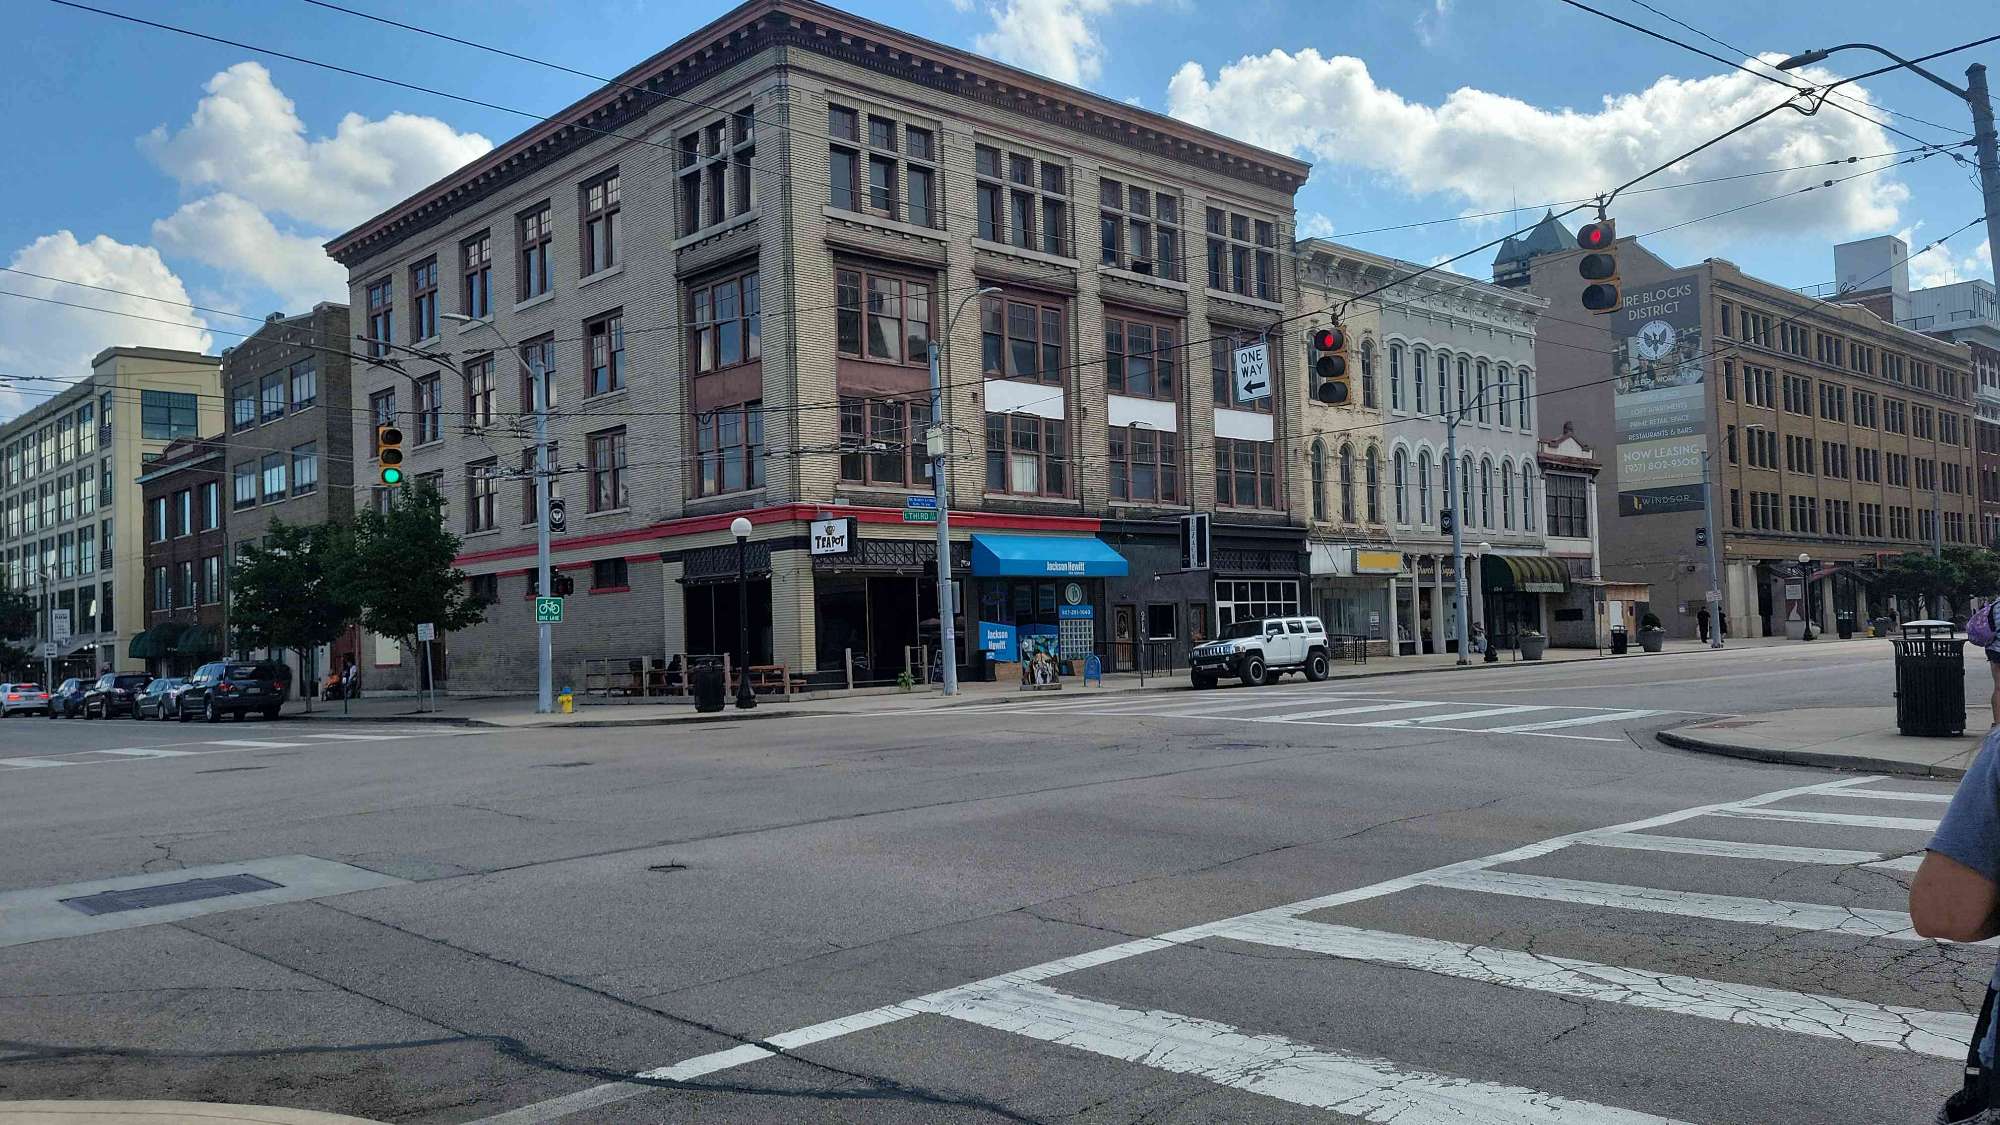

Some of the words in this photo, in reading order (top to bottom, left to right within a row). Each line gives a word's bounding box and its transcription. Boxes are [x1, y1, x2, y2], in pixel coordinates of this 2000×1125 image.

[1622, 294, 1640, 308] IRE
[1643, 284, 1692, 304] BLOCKS
[1628, 301, 1680, 320] DISTRICT
[1241, 349, 1262, 364] ONE
[1241, 363, 1263, 378] WAY
[1628, 430, 1669, 441] RESTAURANTS
[1677, 425, 1693, 435] BARS
[1623, 449, 1652, 463] NOW
[1654, 444, 1698, 459] LEASING
[1642, 494, 1690, 505] WINDSOR
[910, 512, 929, 520] THIRD
[815, 535, 845, 549] TEAPOT
[1047, 561, 1067, 571] Jackson
[1068, 561, 1085, 571] Hewitt
[987, 630, 1008, 639] Jackson
